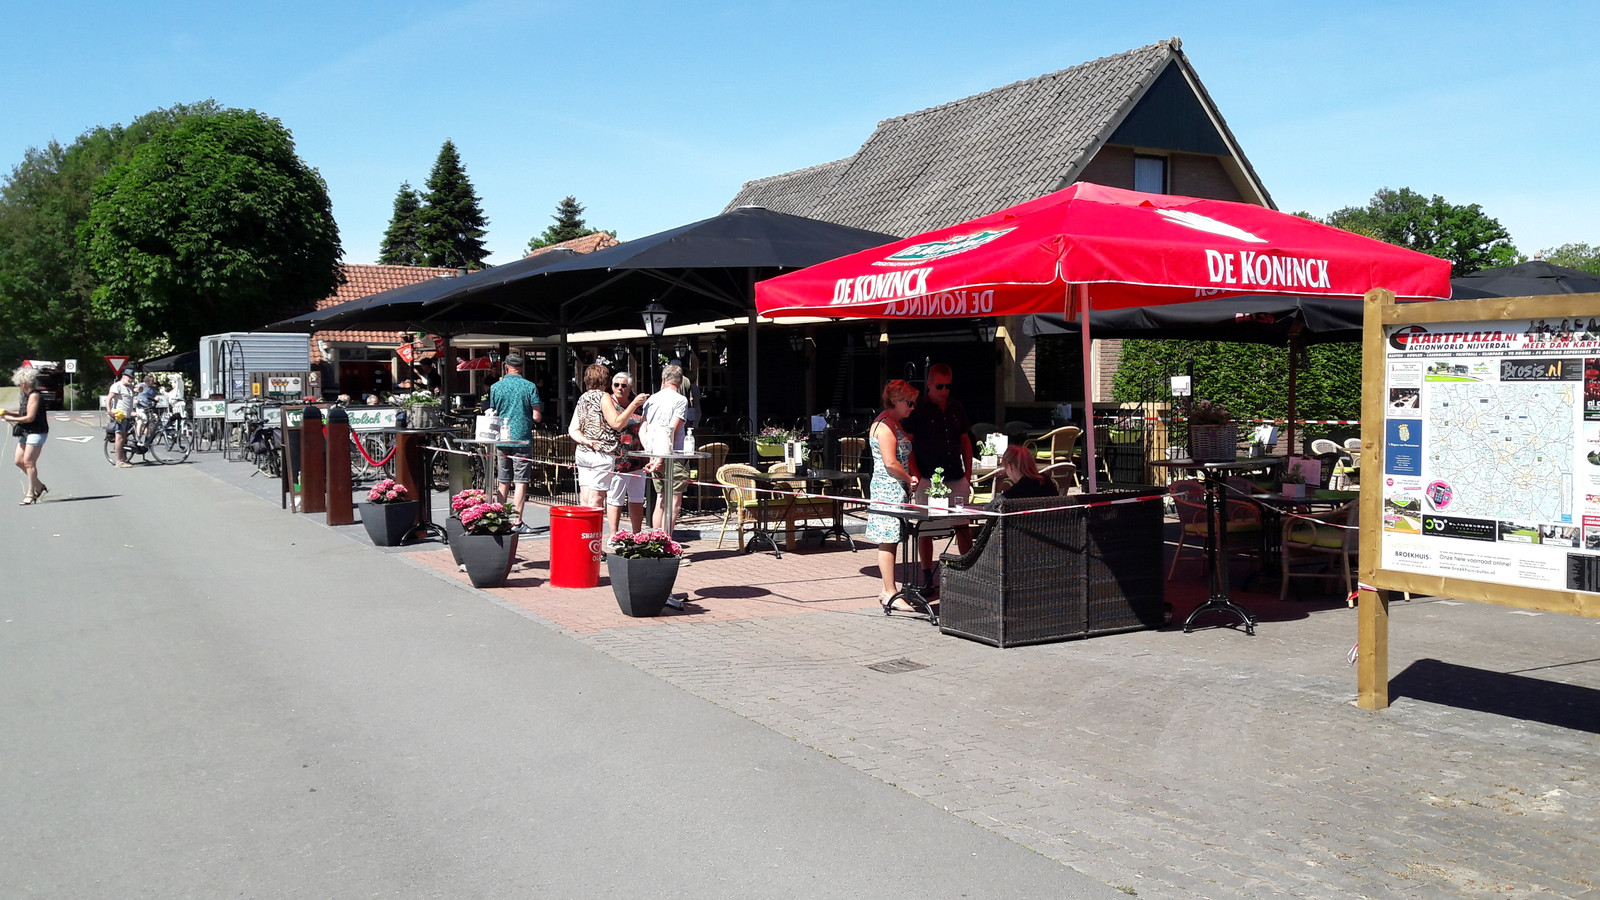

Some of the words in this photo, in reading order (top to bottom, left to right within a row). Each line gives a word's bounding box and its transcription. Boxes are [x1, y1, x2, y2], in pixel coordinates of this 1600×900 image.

[1205, 249, 1237, 284] DE
[1239, 250, 1331, 289] KONINCK
[829, 278, 855, 305] DE
[852, 267, 933, 304] KONINCK
[1409, 343, 1464, 351] ACTIONWORLD
[1501, 361, 1562, 380] Brosis.nl
